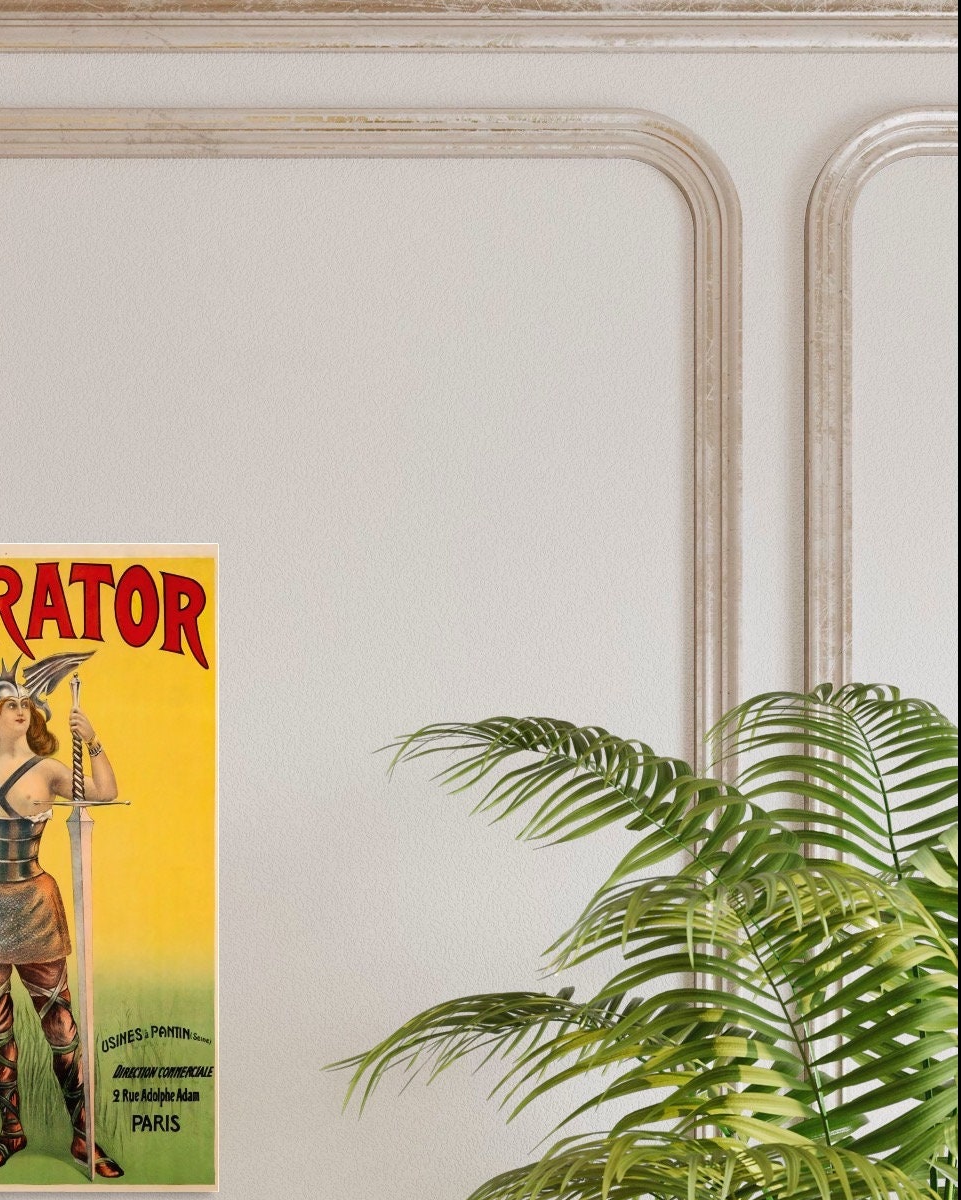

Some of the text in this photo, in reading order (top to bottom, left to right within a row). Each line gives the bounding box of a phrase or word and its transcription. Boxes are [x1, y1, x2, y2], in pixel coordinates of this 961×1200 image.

[101, 1027, 143, 1053] USINES
[150, 1025, 190, 1040] PANTIN
[112, 1064, 214, 1079] DIRECTION COMMERCIALE
[122, 1088, 139, 1102] Rue
[141, 1087, 175, 1107] Adolphe
[176, 1087, 200, 1102] Adam
[132, 1114, 181, 1132] PARIS
